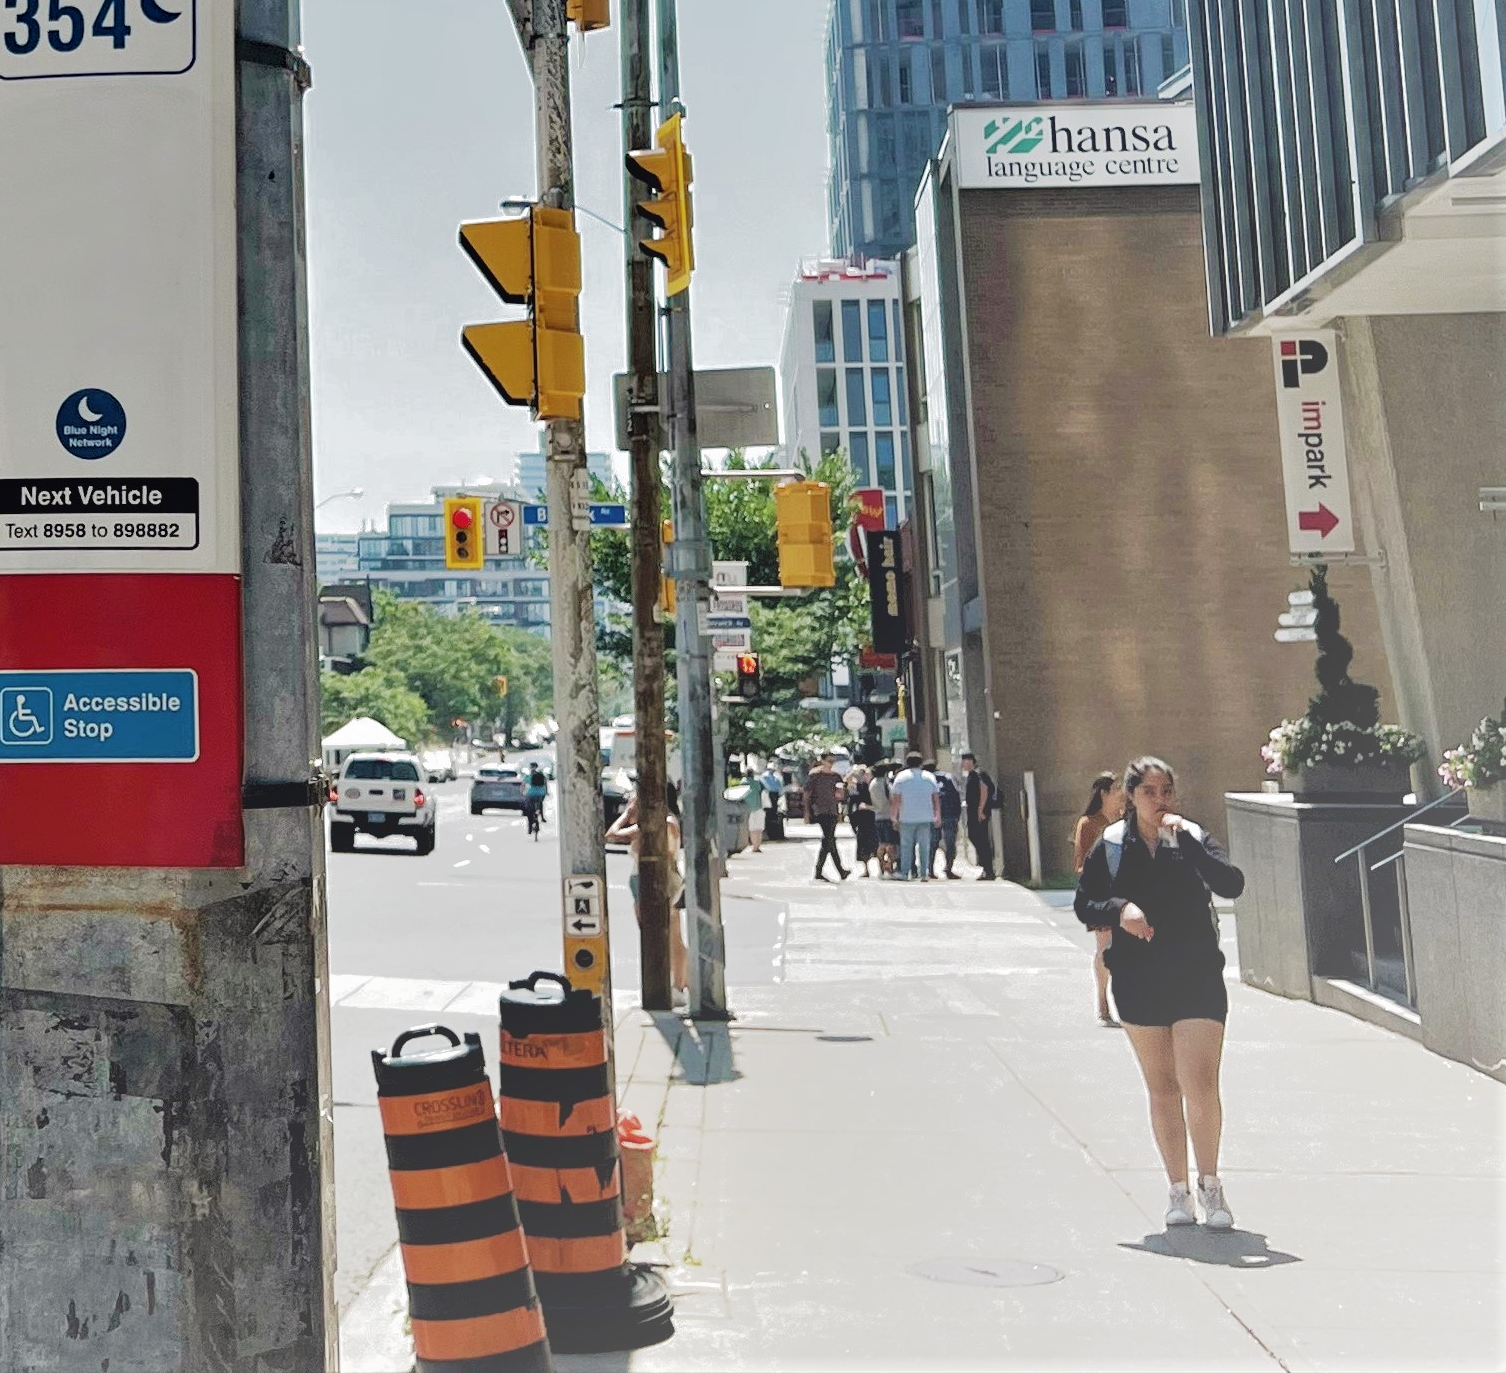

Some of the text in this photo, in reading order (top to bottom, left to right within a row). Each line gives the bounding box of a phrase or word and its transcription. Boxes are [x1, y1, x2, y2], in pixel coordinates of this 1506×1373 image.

[1048, 115, 1178, 153] hansa
[987, 156, 1180, 183] language centre
[63, 425, 118, 436] Blue Night
[69, 438, 113, 447] Network
[1297, 401, 1332, 489] impark
[20, 485, 162, 505] Next Vehicle
[5, 523, 180, 538] Text 8958 to 898882
[63, 693, 181, 712] Accessible
[63, 719, 113, 742] Stop
